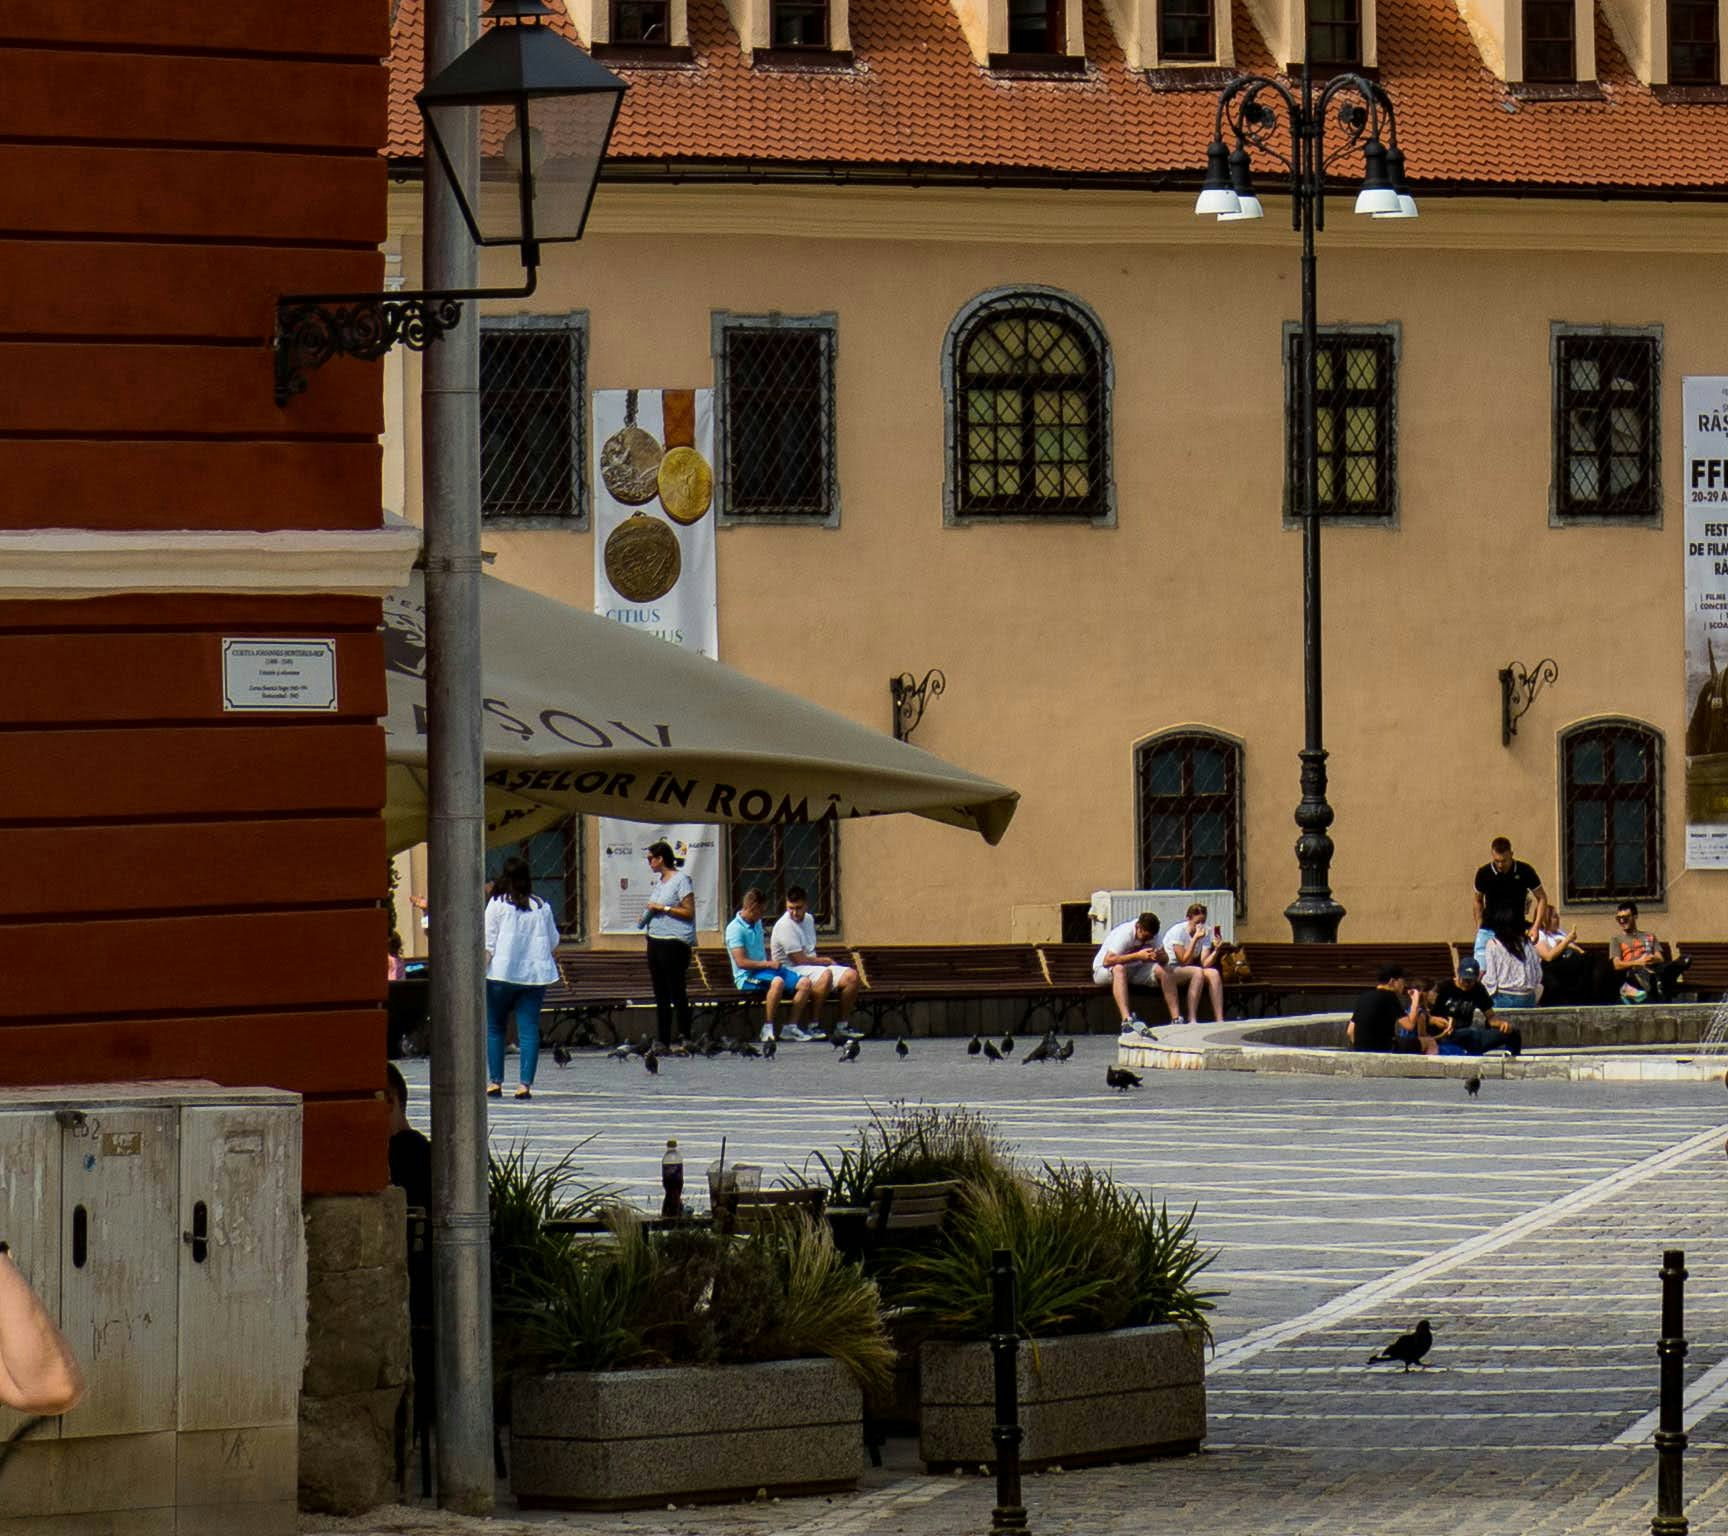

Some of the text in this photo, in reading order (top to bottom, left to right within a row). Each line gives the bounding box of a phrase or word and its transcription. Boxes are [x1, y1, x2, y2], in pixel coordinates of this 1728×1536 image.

[1691, 490, 1719, 503] 20-29
[1689, 542, 1705, 556] DE
[606, 608, 661, 623] CITIUS
[484, 768, 637, 799] AȘELOR
[644, 769, 700, 806] ÎN
